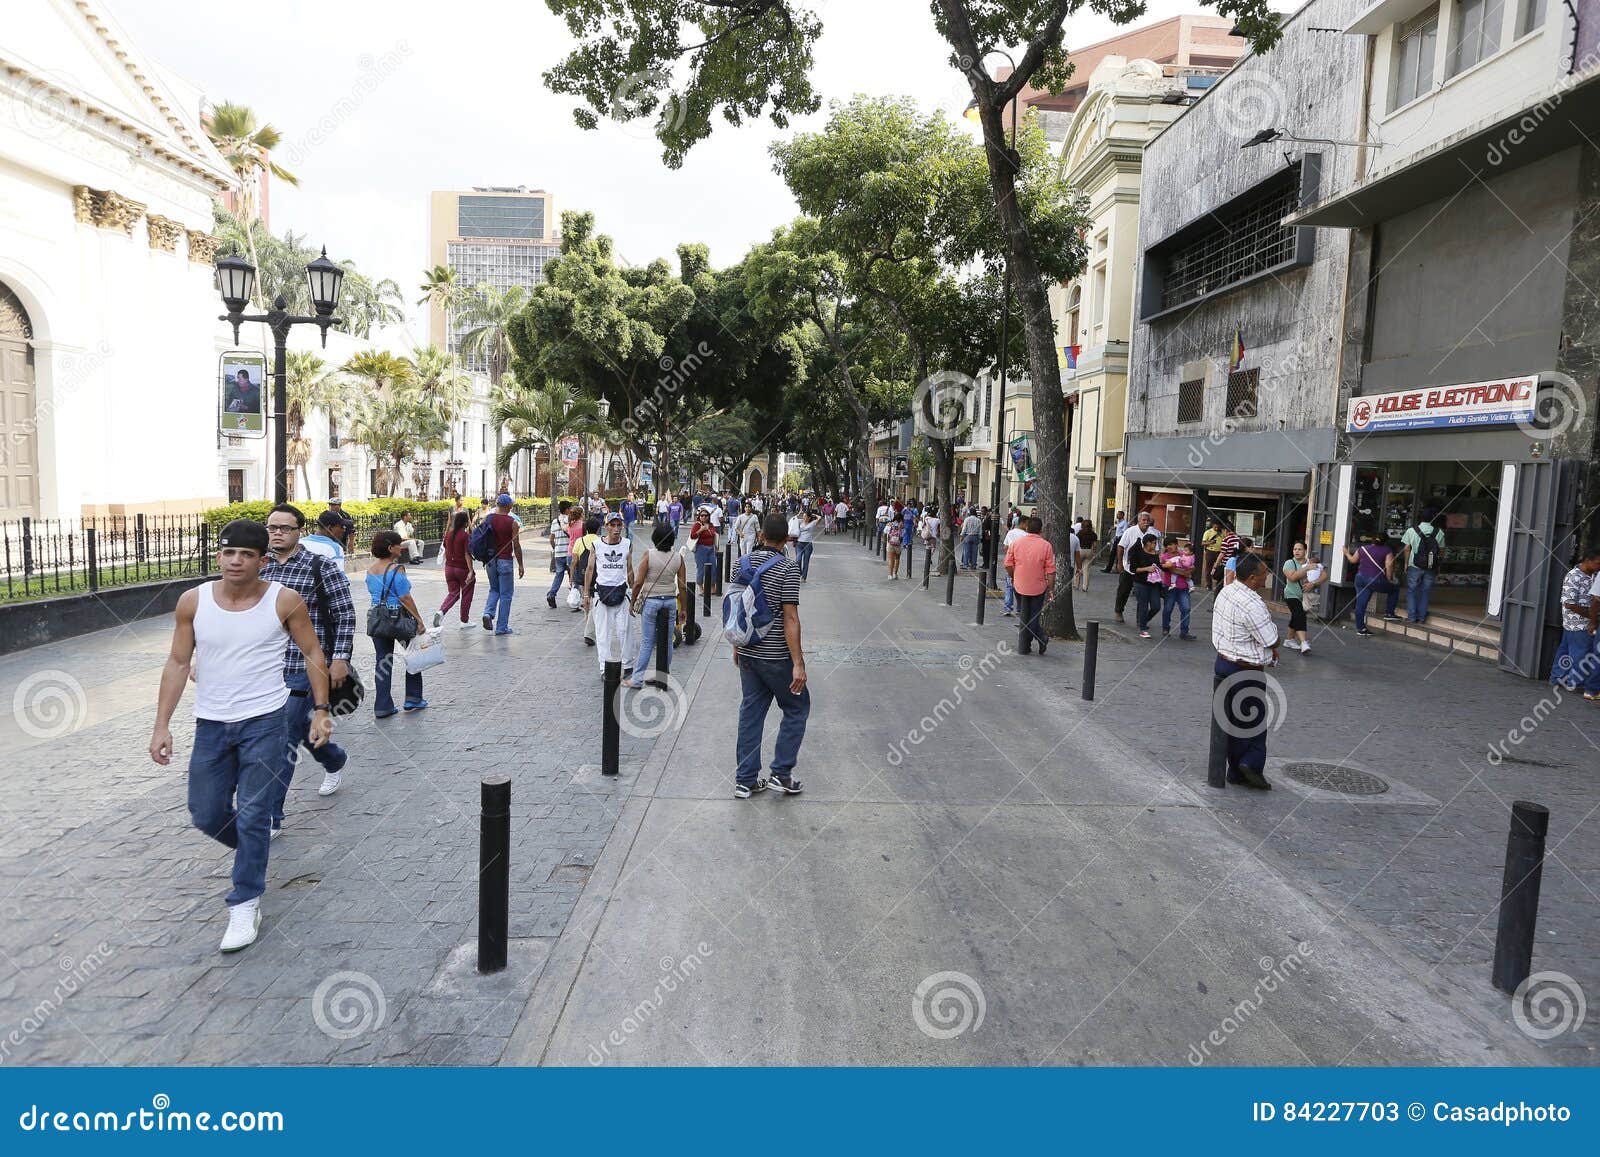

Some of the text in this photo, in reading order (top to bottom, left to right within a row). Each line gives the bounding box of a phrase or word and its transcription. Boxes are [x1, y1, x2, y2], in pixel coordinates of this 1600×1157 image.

[1375, 381, 1532, 414] HOUSE ELECTRONIC
[1448, 416, 1465, 424] Audio
[1490, 413, 1508, 421] Video
